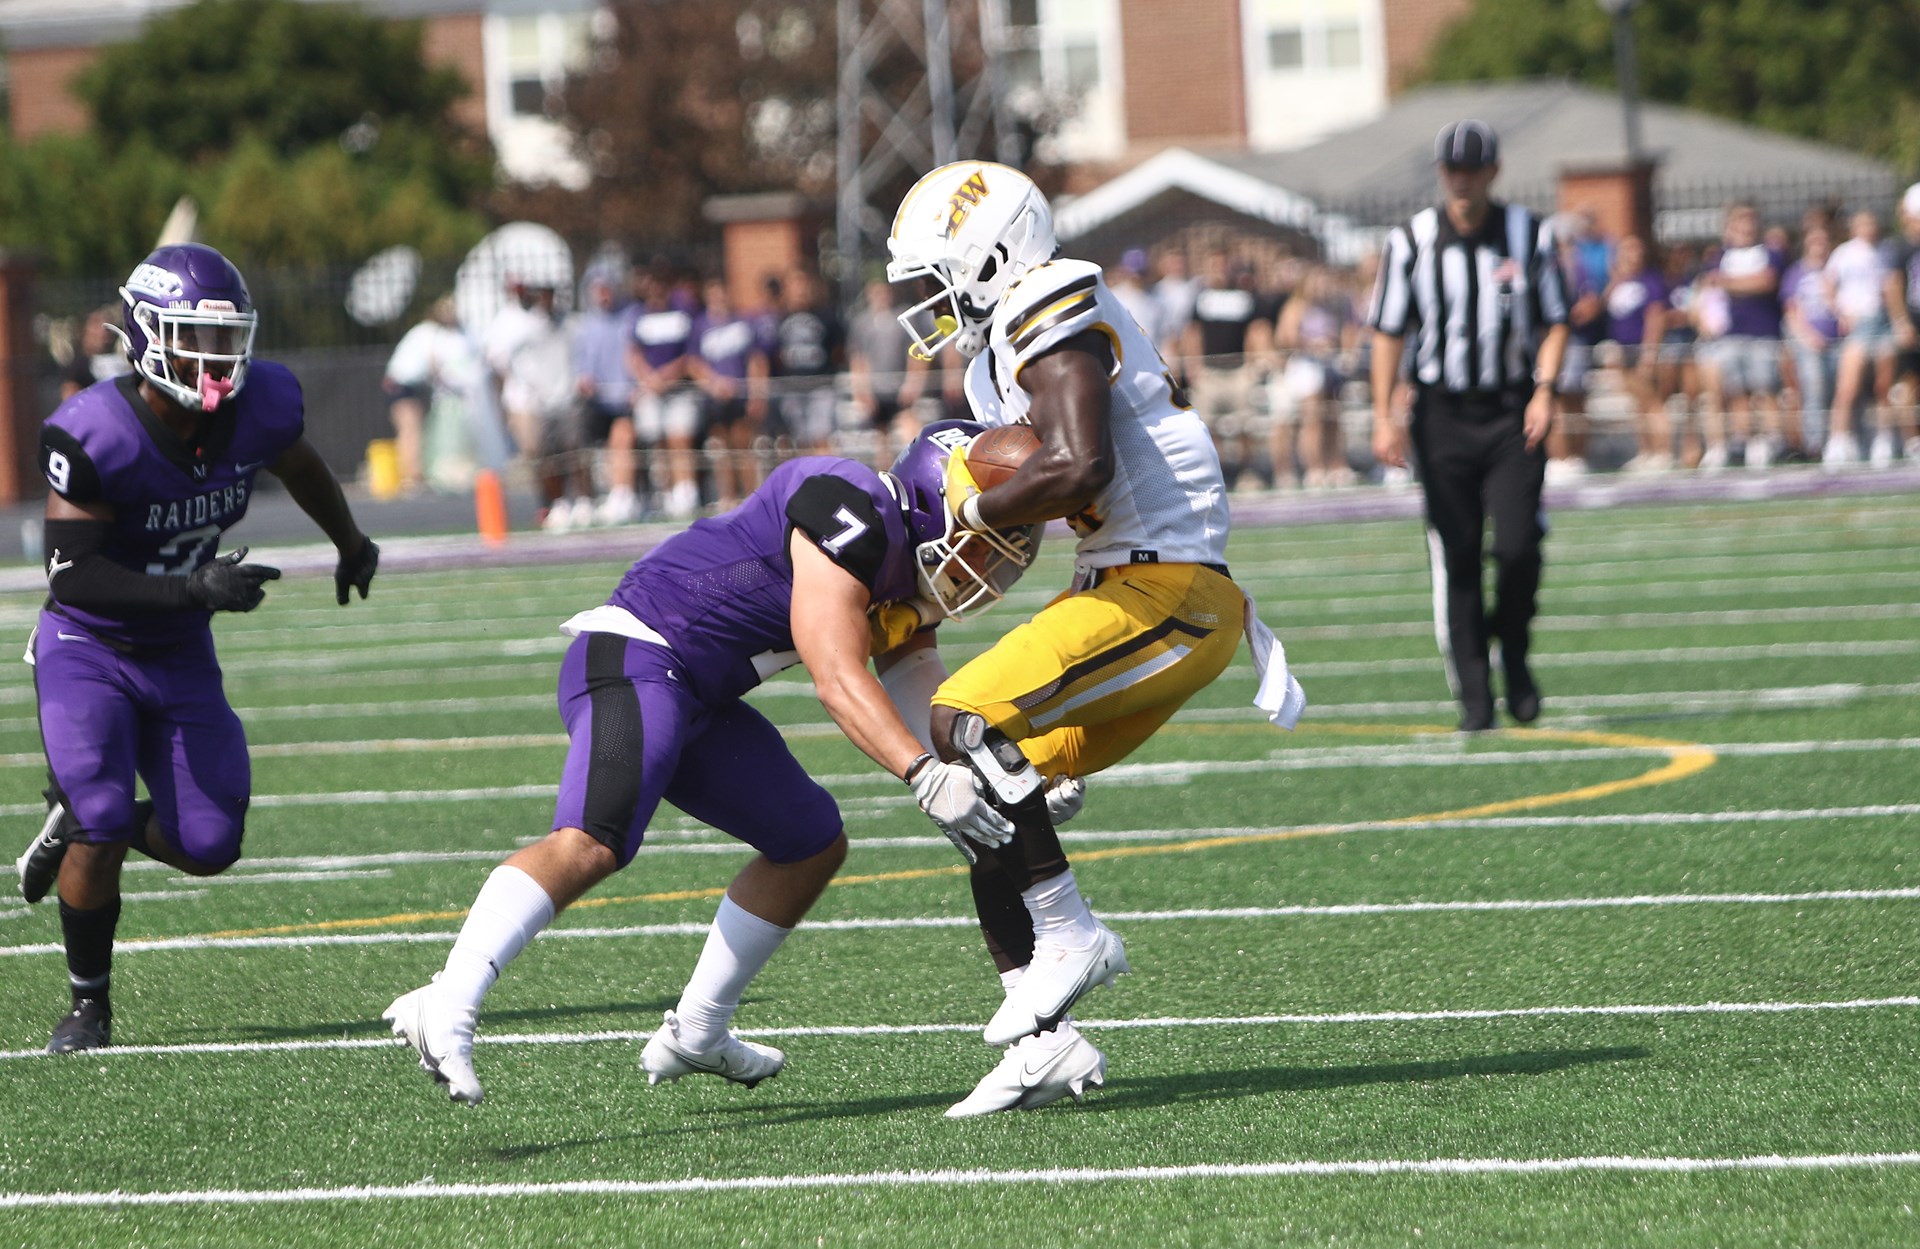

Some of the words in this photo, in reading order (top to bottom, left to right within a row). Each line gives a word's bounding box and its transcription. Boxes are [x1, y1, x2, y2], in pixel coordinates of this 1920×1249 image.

[46, 448, 71, 495] 9
[145, 479, 246, 531] RAIDERS
[818, 504, 869, 558] 7
[1138, 552, 1149, 562] M
